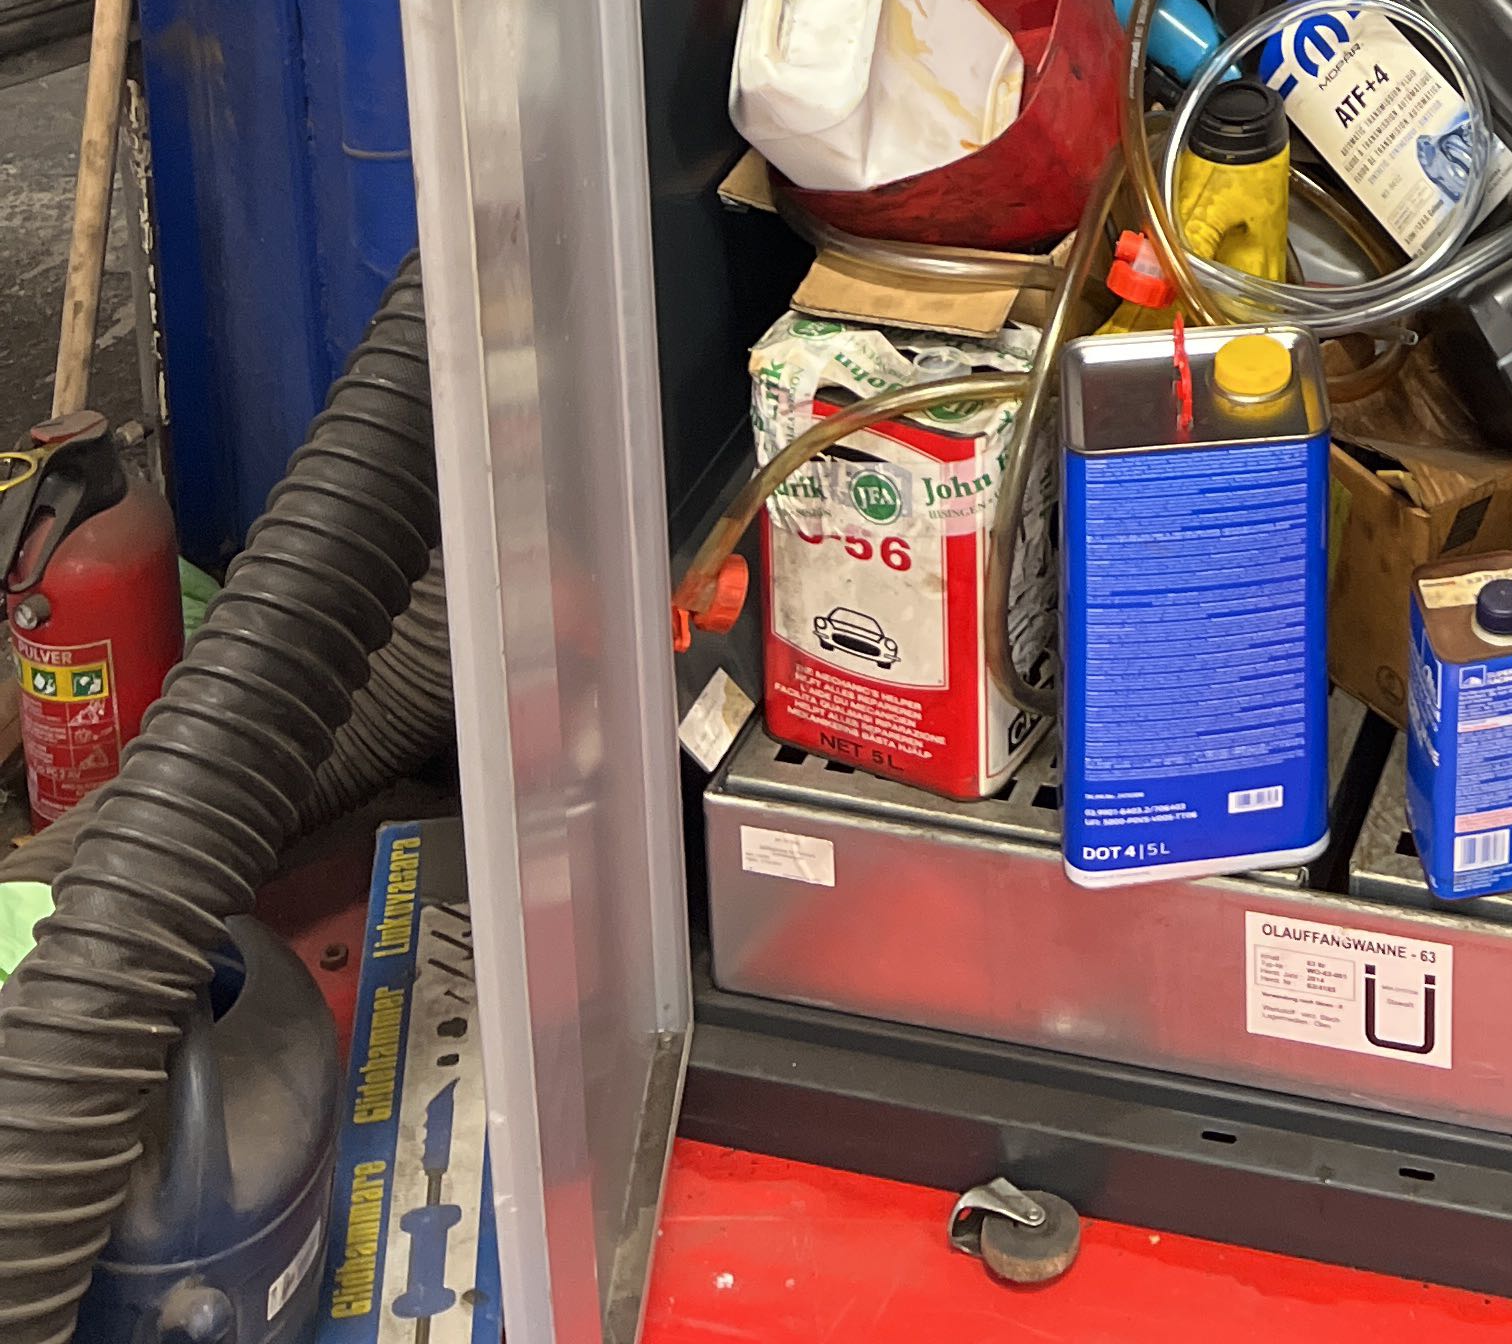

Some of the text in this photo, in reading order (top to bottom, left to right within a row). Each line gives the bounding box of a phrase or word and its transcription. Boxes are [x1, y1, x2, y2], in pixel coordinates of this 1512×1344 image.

[1318, 42, 1363, 92] MOPAR
[1334, 63, 1391, 130] ATF+4
[858, 486, 896, 510] JFA
[921, 472, 993, 507] John
[17, 639, 73, 664] PULVER
[818, 731, 863, 759] NET
[1082, 846, 1122, 861] DOT
[1124, 844, 1137, 858] 4
[1419, 949, 1437, 964] 63
[352, 985, 406, 1125] Glidehammer
[331, 1158, 387, 1320] Glidhammare
